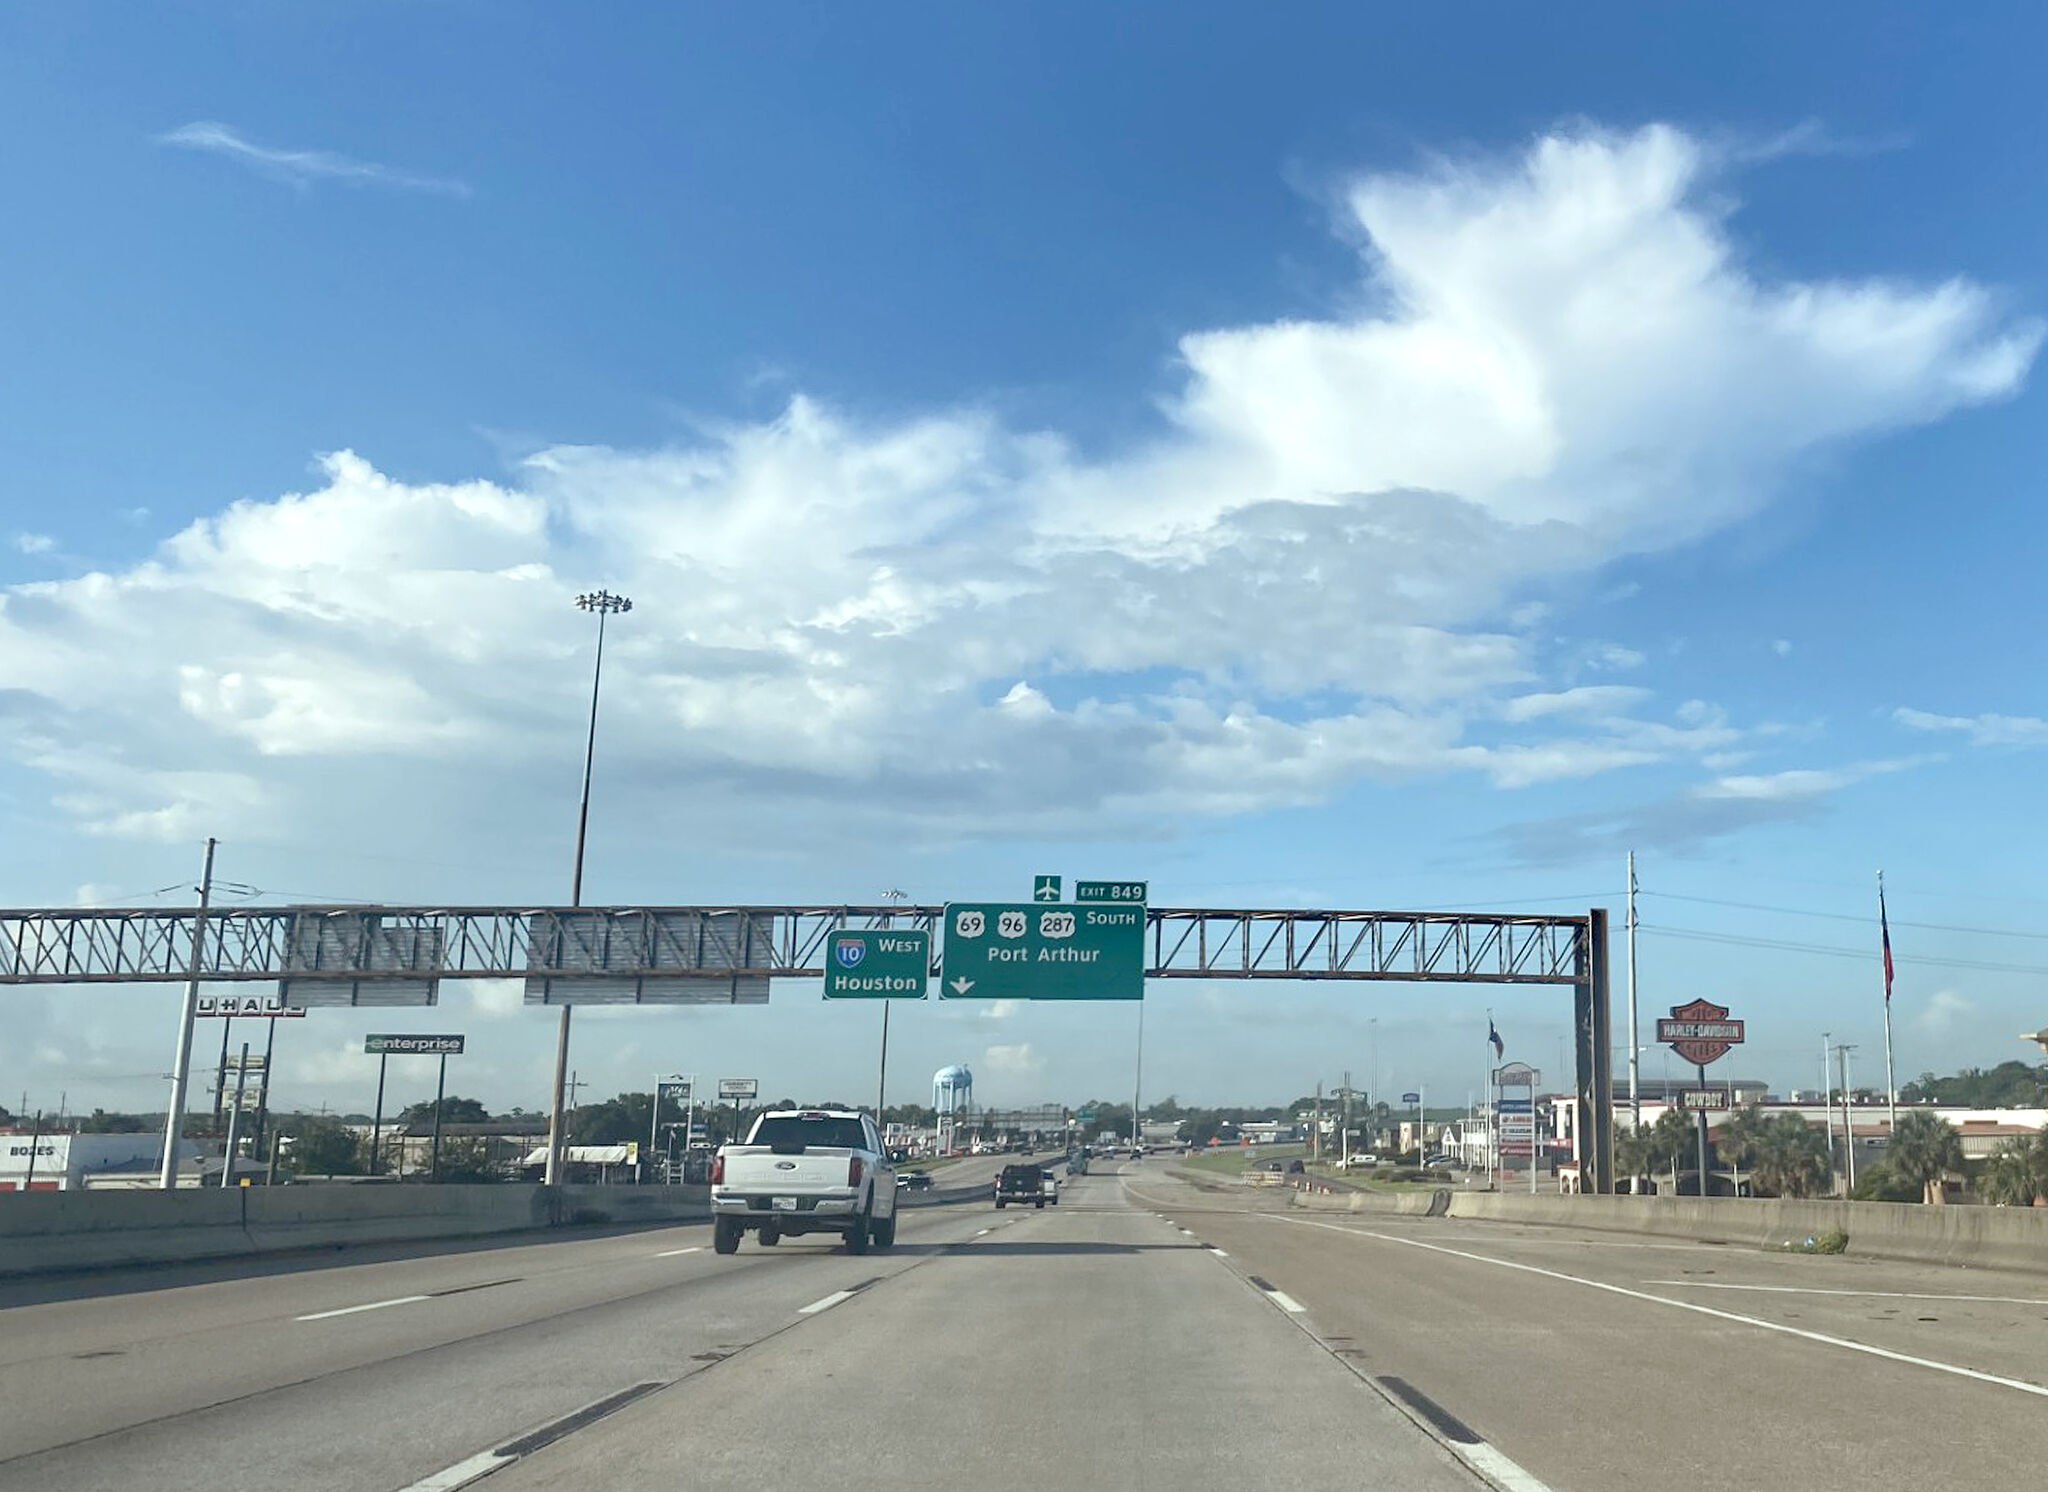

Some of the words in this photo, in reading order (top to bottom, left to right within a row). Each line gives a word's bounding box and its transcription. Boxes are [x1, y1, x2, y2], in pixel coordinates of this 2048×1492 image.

[1080, 886, 1104, 897] EXIT
[1111, 885, 1142, 899] 849
[960, 917, 981, 931] 69
[1002, 917, 1023, 932] 96
[1043, 917, 1073, 932] 287
[1086, 911, 1136, 925] SOUTH
[878, 938, 922, 952] WEST
[841, 946, 859, 960] 10
[988, 947, 1028, 962] Port
[1038, 947, 1100, 962] Arthur
[835, 976, 917, 991] Houston
[370, 1037, 461, 1052] enterprise
[1684, 1092, 1724, 1108] COWBOY
